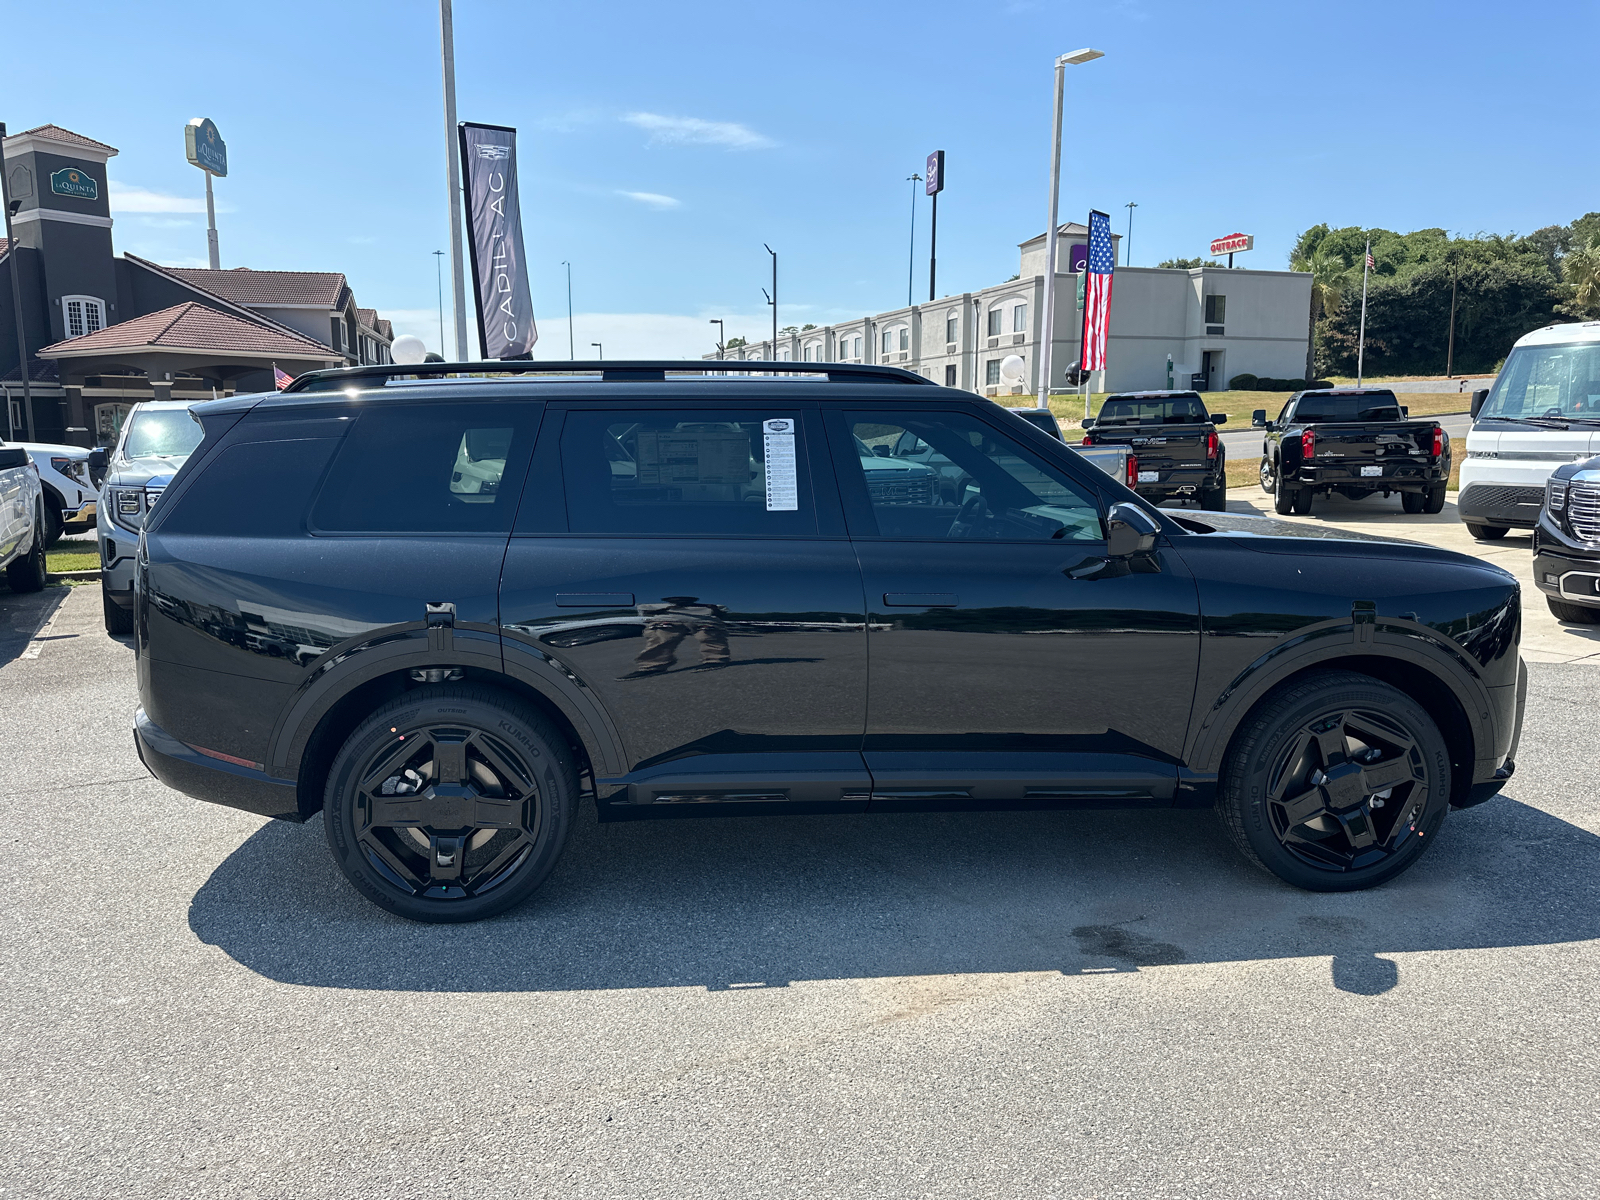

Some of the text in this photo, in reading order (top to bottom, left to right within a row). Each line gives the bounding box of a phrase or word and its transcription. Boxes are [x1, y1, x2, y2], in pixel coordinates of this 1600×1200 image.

[62, 182, 95, 193] QUINTA
[1211, 238, 1248, 251] OUTBACK
[1132, 437, 1167, 446] GMC
[1405, 709, 1425, 728] OUTSIDE
[498, 719, 541, 759] KUMHO
[1435, 750, 1446, 797] KUMHO
[1251, 785, 1264, 832] KUMHO
[353, 868, 396, 906] KUMHO
